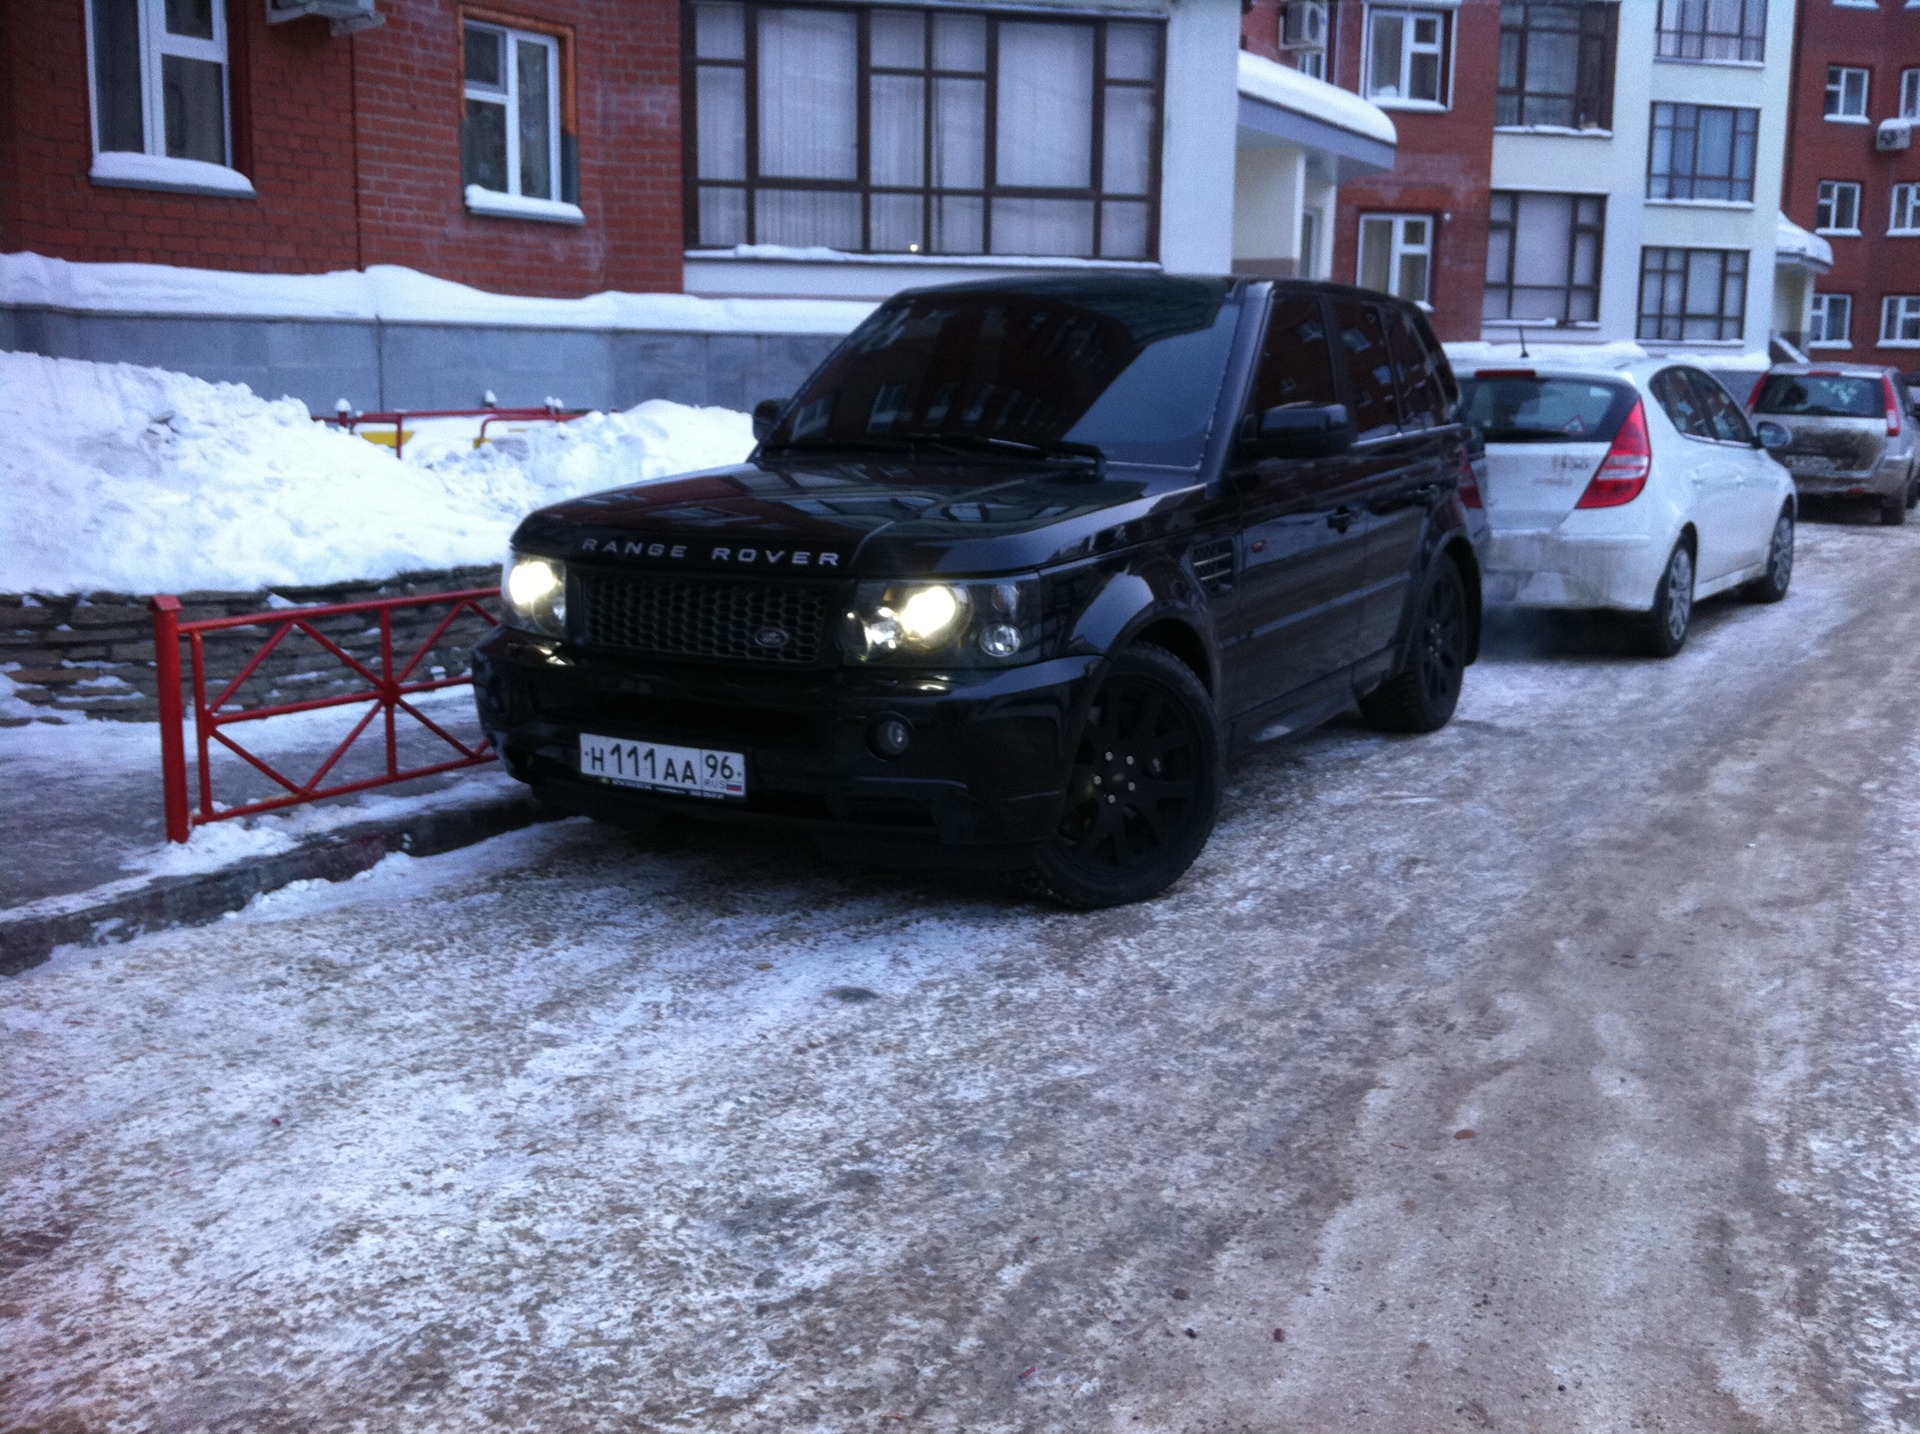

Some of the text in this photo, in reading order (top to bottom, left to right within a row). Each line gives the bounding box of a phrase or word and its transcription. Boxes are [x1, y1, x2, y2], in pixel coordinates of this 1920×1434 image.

[582, 538, 840, 566] RANGE ROVER
[703, 778, 726, 790] RUS
